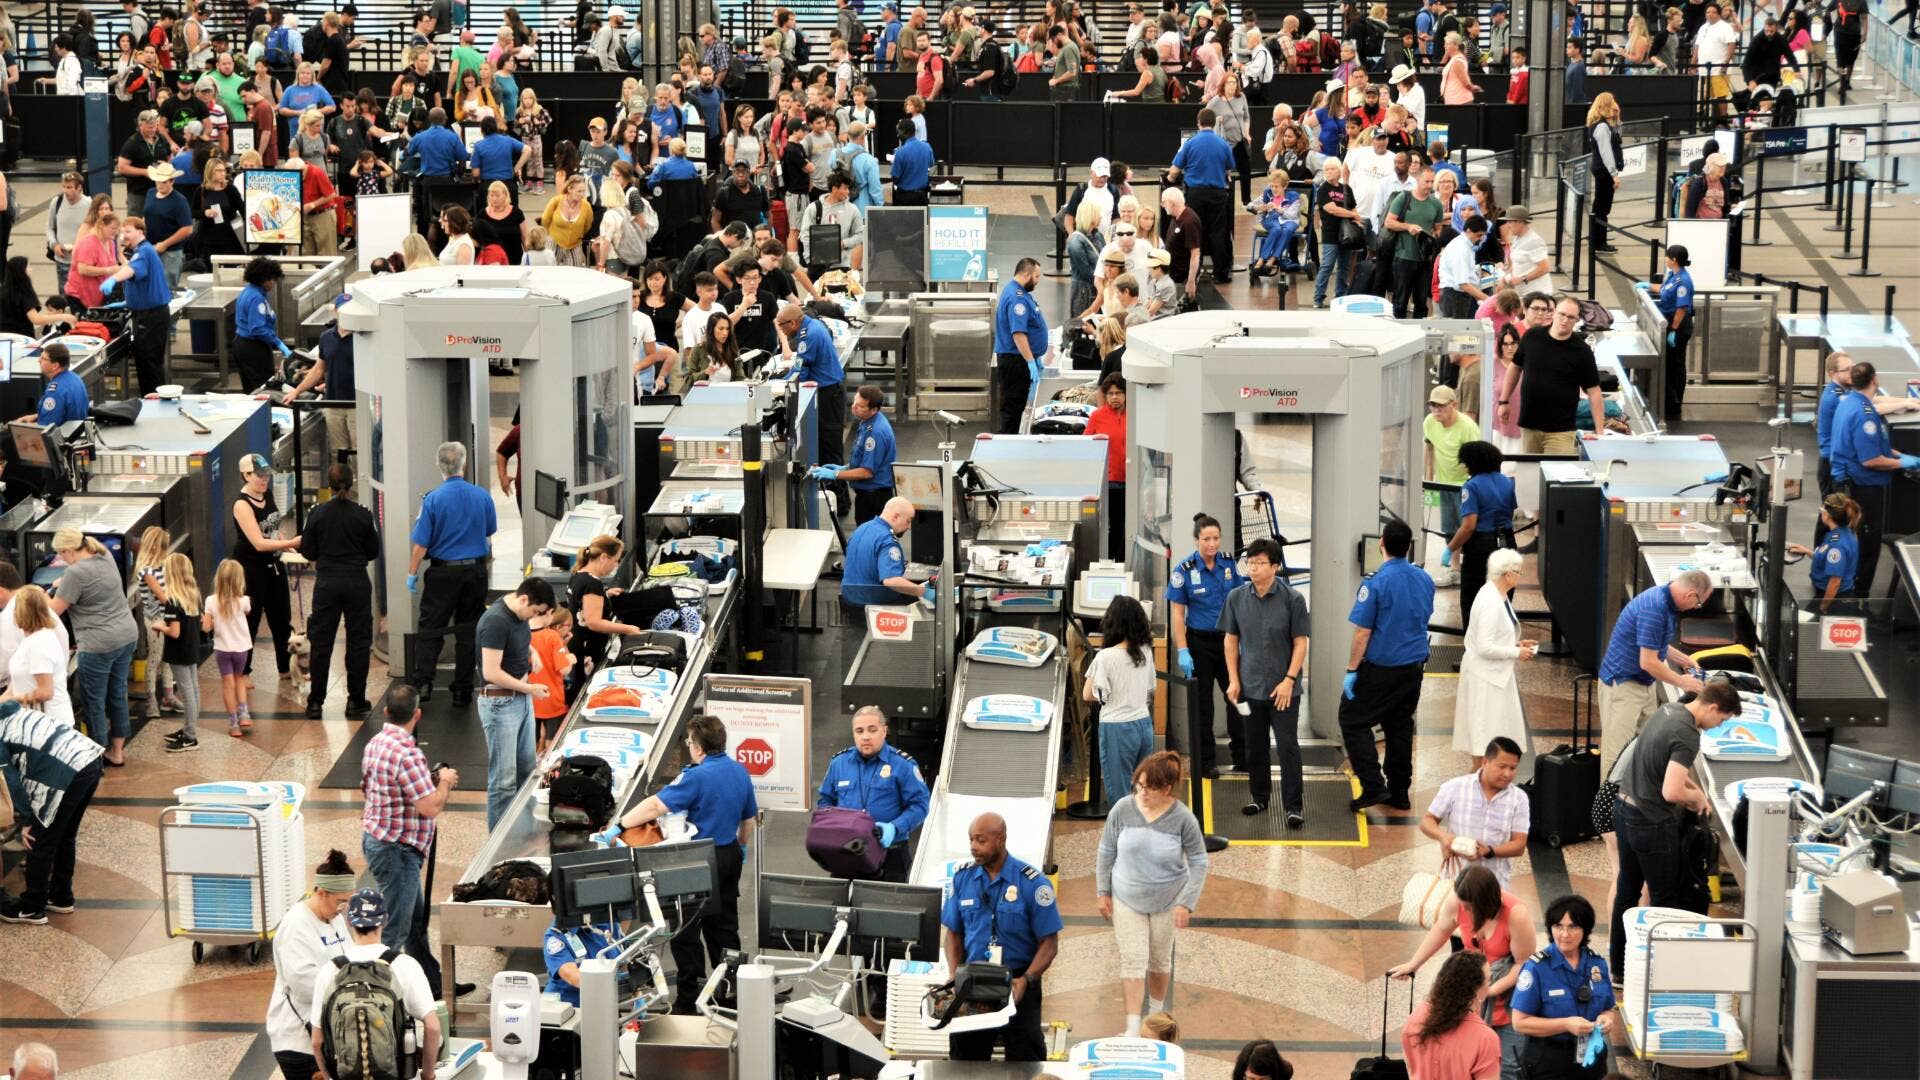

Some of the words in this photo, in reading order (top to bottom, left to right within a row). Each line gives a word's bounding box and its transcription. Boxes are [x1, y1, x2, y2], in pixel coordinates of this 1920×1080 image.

[935, 229, 967, 238] HOLD
[970, 229, 981, 238] IT
[456, 335, 502, 344] ProVision
[482, 345, 502, 353] ATD
[1252, 388, 1298, 397] ProVision
[1277, 397, 1298, 406] ATD
[943, 450, 950, 463] 6
[879, 617, 905, 627] STOP
[1832, 628, 1859, 638] STOP
[738, 749, 773, 765] STOP
[1764, 807, 1786, 815] iLane
